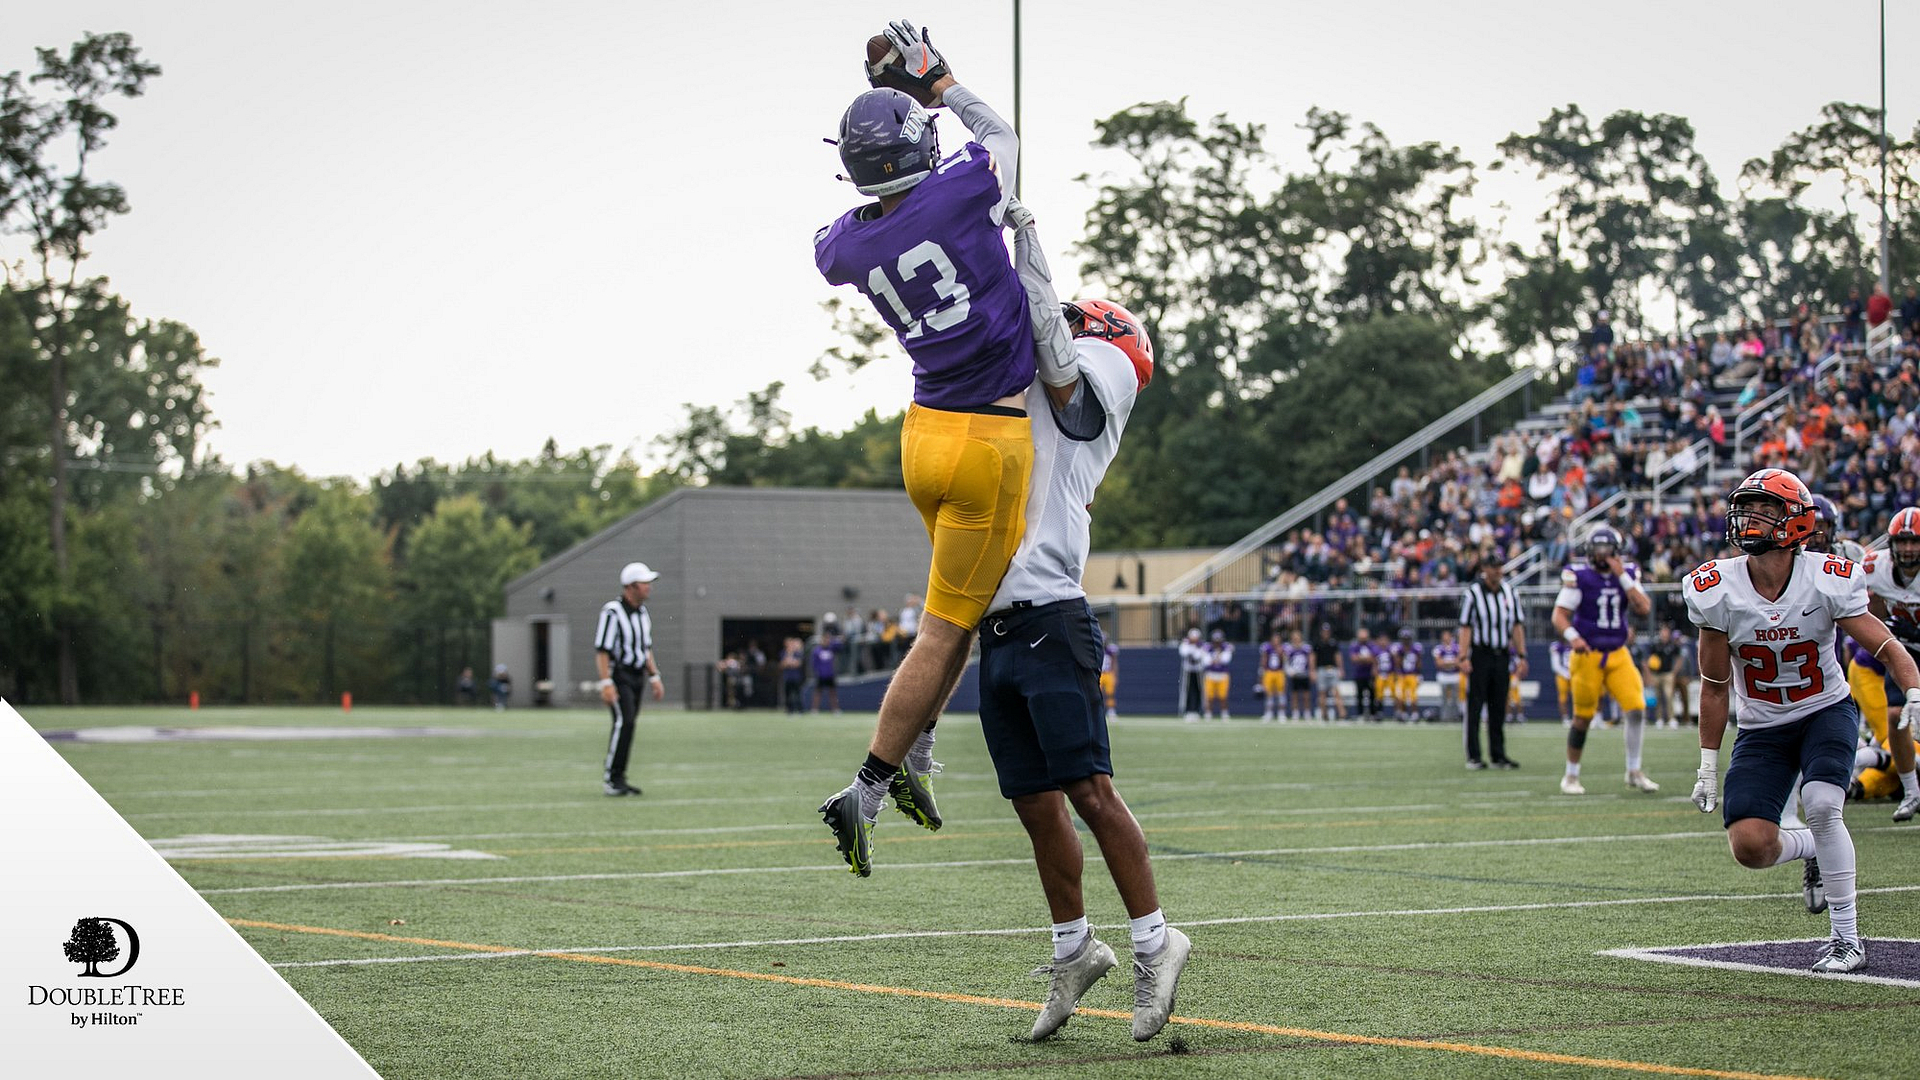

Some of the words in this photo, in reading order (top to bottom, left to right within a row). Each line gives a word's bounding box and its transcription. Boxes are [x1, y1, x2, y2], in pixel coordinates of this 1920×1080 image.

[883, 162, 893, 174] 13
[868, 240, 971, 339] 13
[1597, 595, 1620, 629] 11
[1754, 627, 1800, 642] HOPE
[1738, 639, 1825, 705] 23
